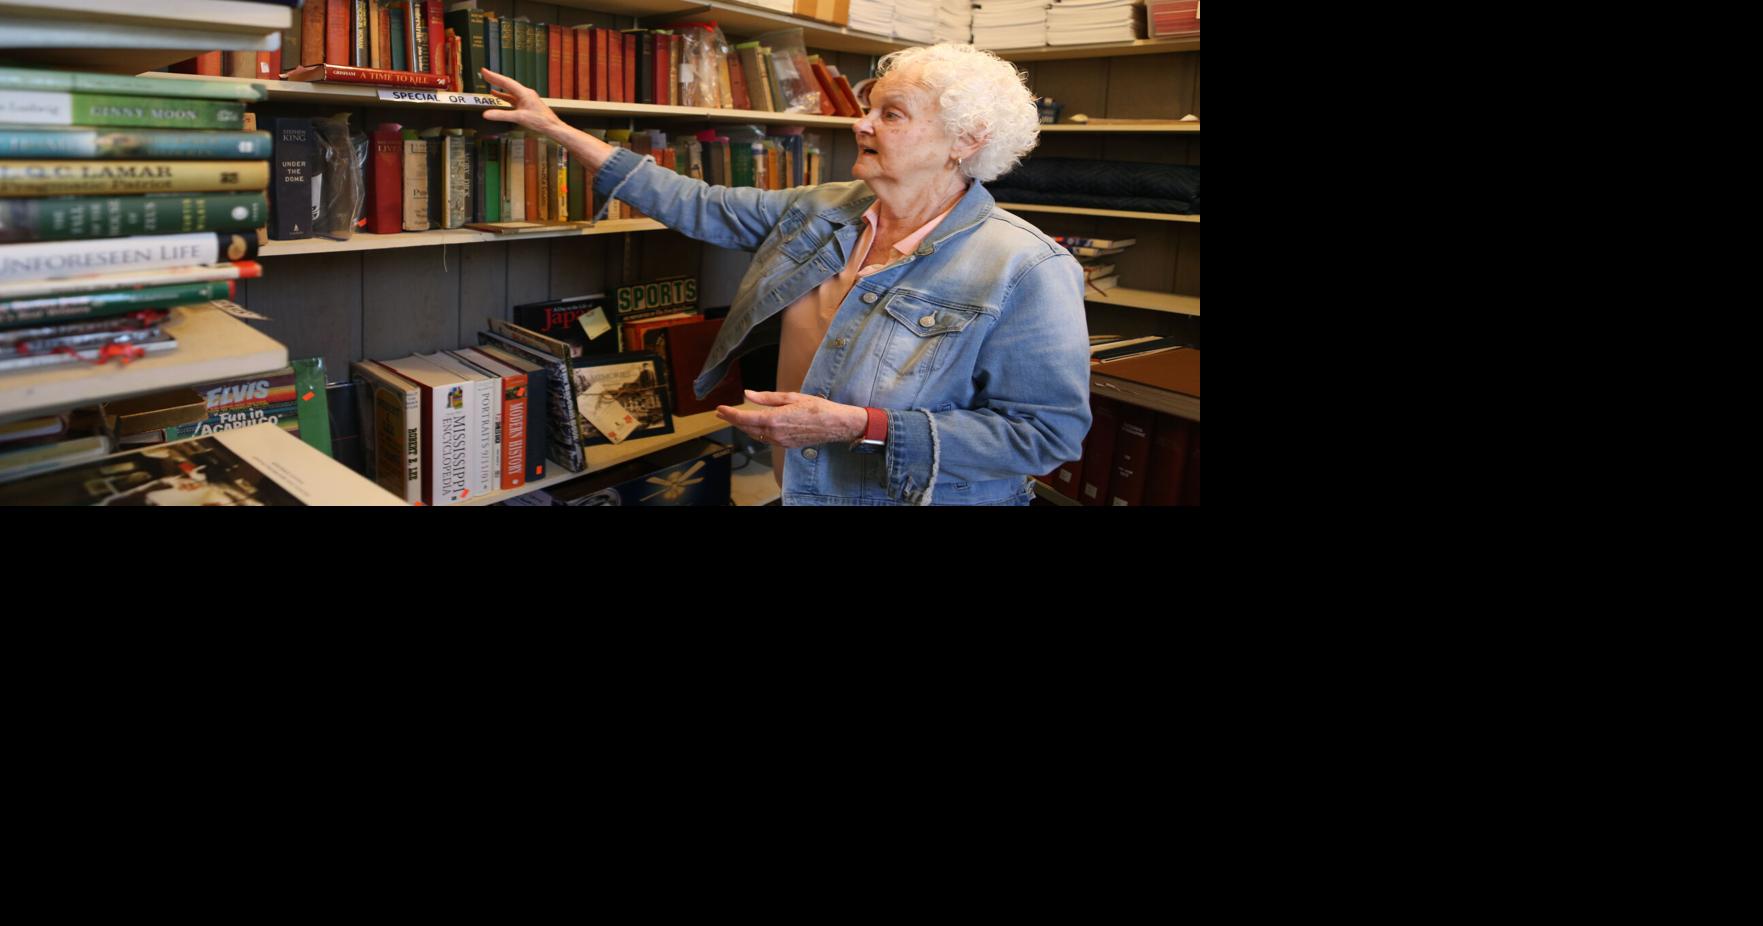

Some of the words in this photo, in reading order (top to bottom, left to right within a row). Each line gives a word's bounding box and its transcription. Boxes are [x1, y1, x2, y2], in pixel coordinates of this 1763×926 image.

[360, 71, 367, 79] A
[370, 72, 392, 82] TIME
[396, 73, 408, 82] TO
[410, 76, 429, 85] KILL
[393, 91, 441, 103] SPECIAL
[449, 95, 466, 104] OR
[474, 96, 503, 106] RARE
[150, 108, 197, 120] MOON
[82, 165, 173, 178] LAMAR
[618, 280, 697, 312] SPORTS
[206, 380, 270, 408] ELVIS
[249, 408, 264, 419] in
[480, 393, 490, 449] PORTRAITS
[508, 402, 524, 439] MODERN
[408, 428, 418, 456] ROBERT
[453, 415, 466, 493] MISSISSIPPI
[442, 418, 452, 496] ENCYCLOPEDIA
[508, 440, 523, 475] HISTORY
[409, 467, 418, 481] LEE
